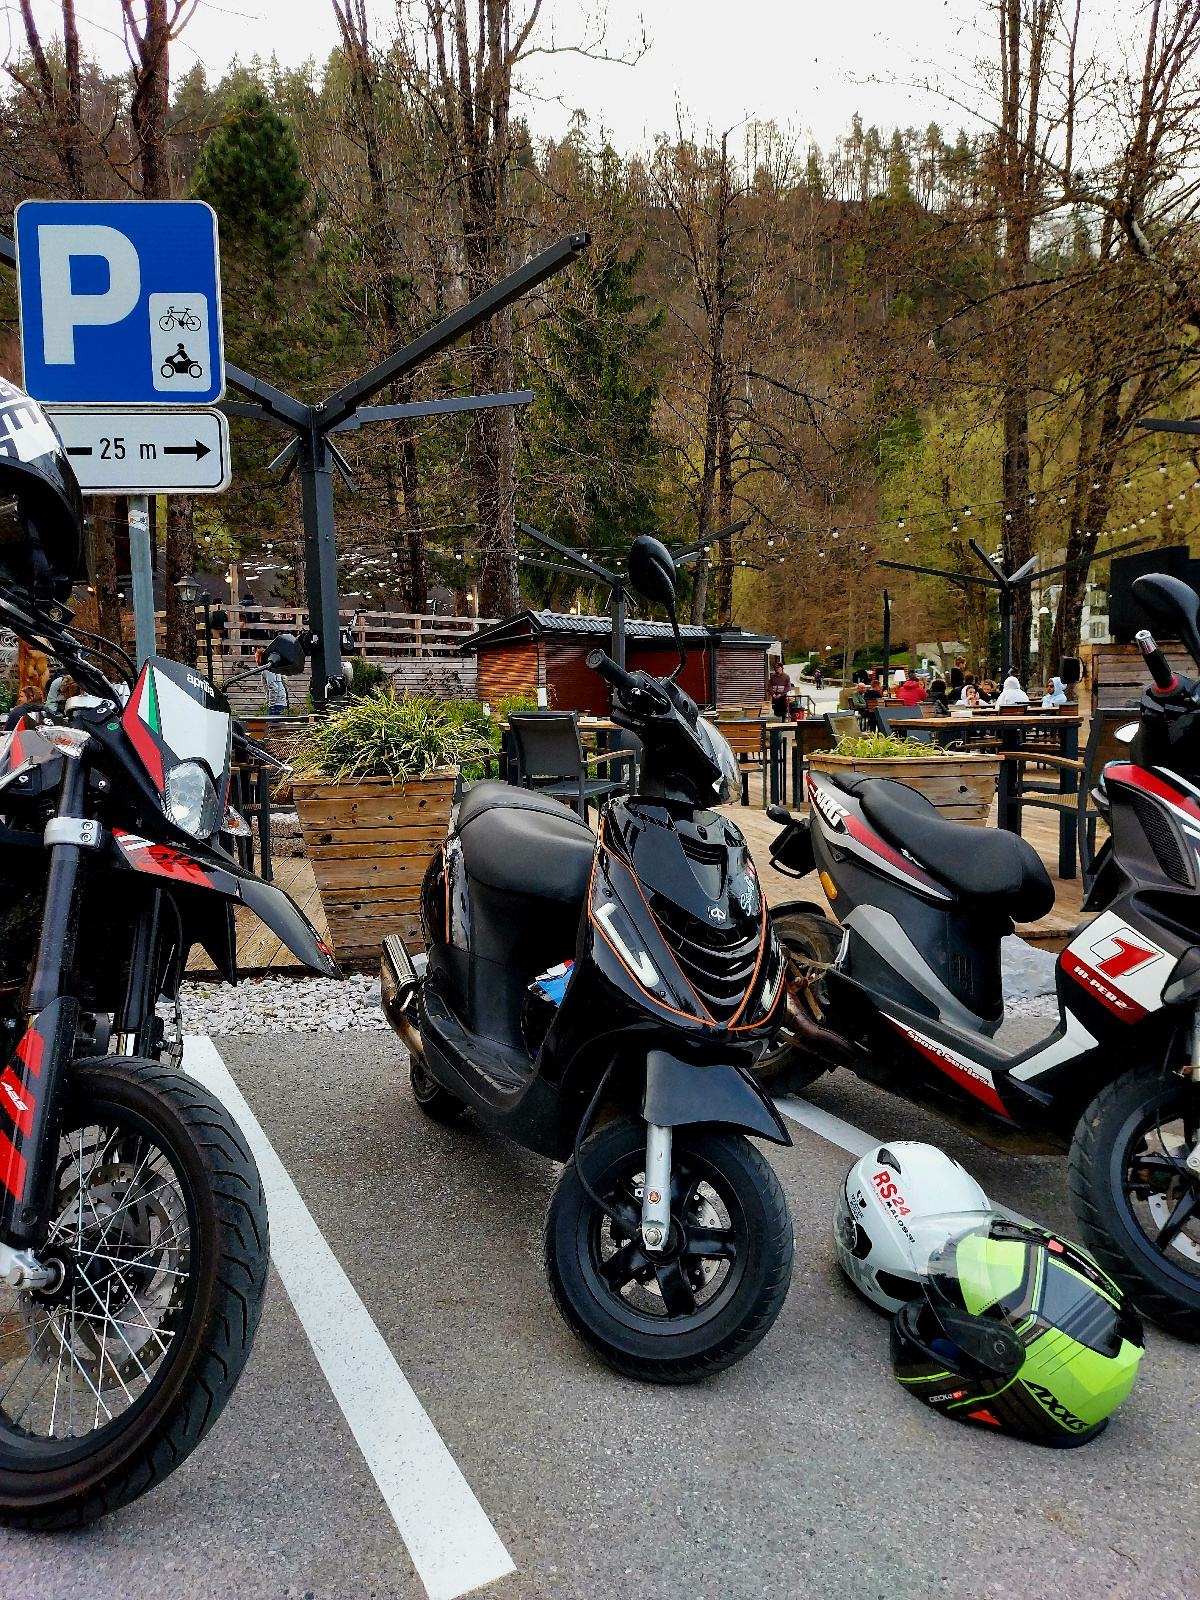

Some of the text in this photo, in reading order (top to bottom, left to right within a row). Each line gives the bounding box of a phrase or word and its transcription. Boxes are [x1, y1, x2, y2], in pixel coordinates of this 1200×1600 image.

[38, 225, 141, 364] P
[99, 438, 157, 460] 25 m
[187, 674, 215, 698] aprilia
[873, 1170, 911, 1216] RS24
